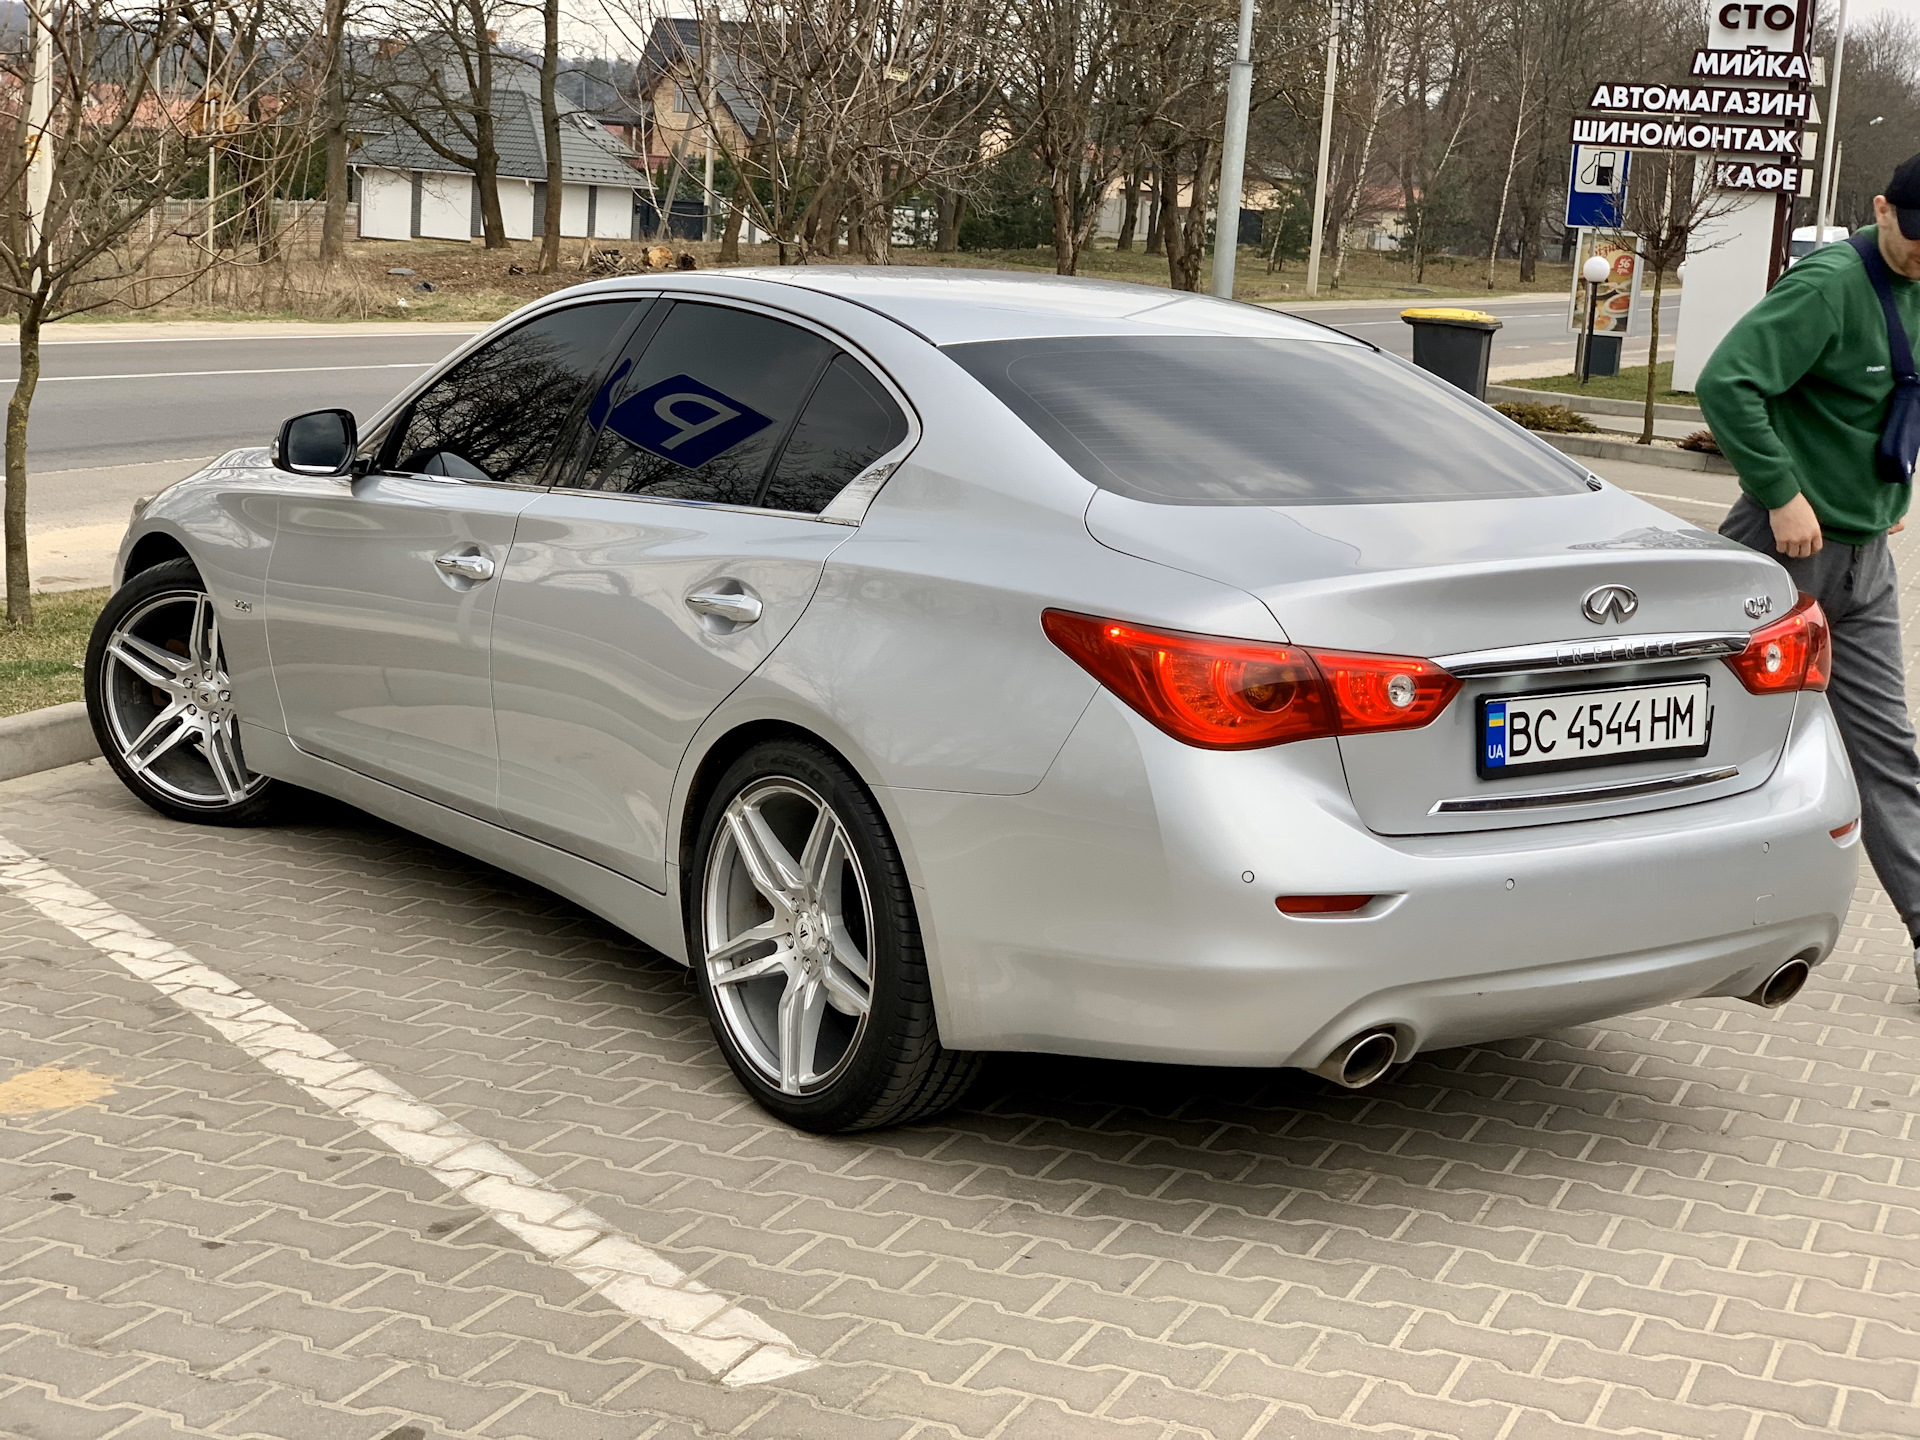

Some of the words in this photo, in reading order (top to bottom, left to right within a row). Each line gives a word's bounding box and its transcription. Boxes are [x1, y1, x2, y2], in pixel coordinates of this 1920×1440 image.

[1718, 3, 1795, 31] СТО
[1692, 49, 1807, 79] МИЙКА
[1591, 85, 1806, 116] АВТОМАГАЗИН
[1572, 119, 1797, 153] ШИНОМОНТАЖ
[1716, 163, 1798, 191] КАФЕ
[1618, 258, 1631, 269] 56
[1744, 595, 1773, 619] Q50
[1555, 639, 1679, 666] INFINITI
[1508, 709, 1557, 757] BC
[1567, 699, 1641, 750] 4544
[1649, 694, 1695, 742] HM
[1488, 744, 1504, 759] UA
